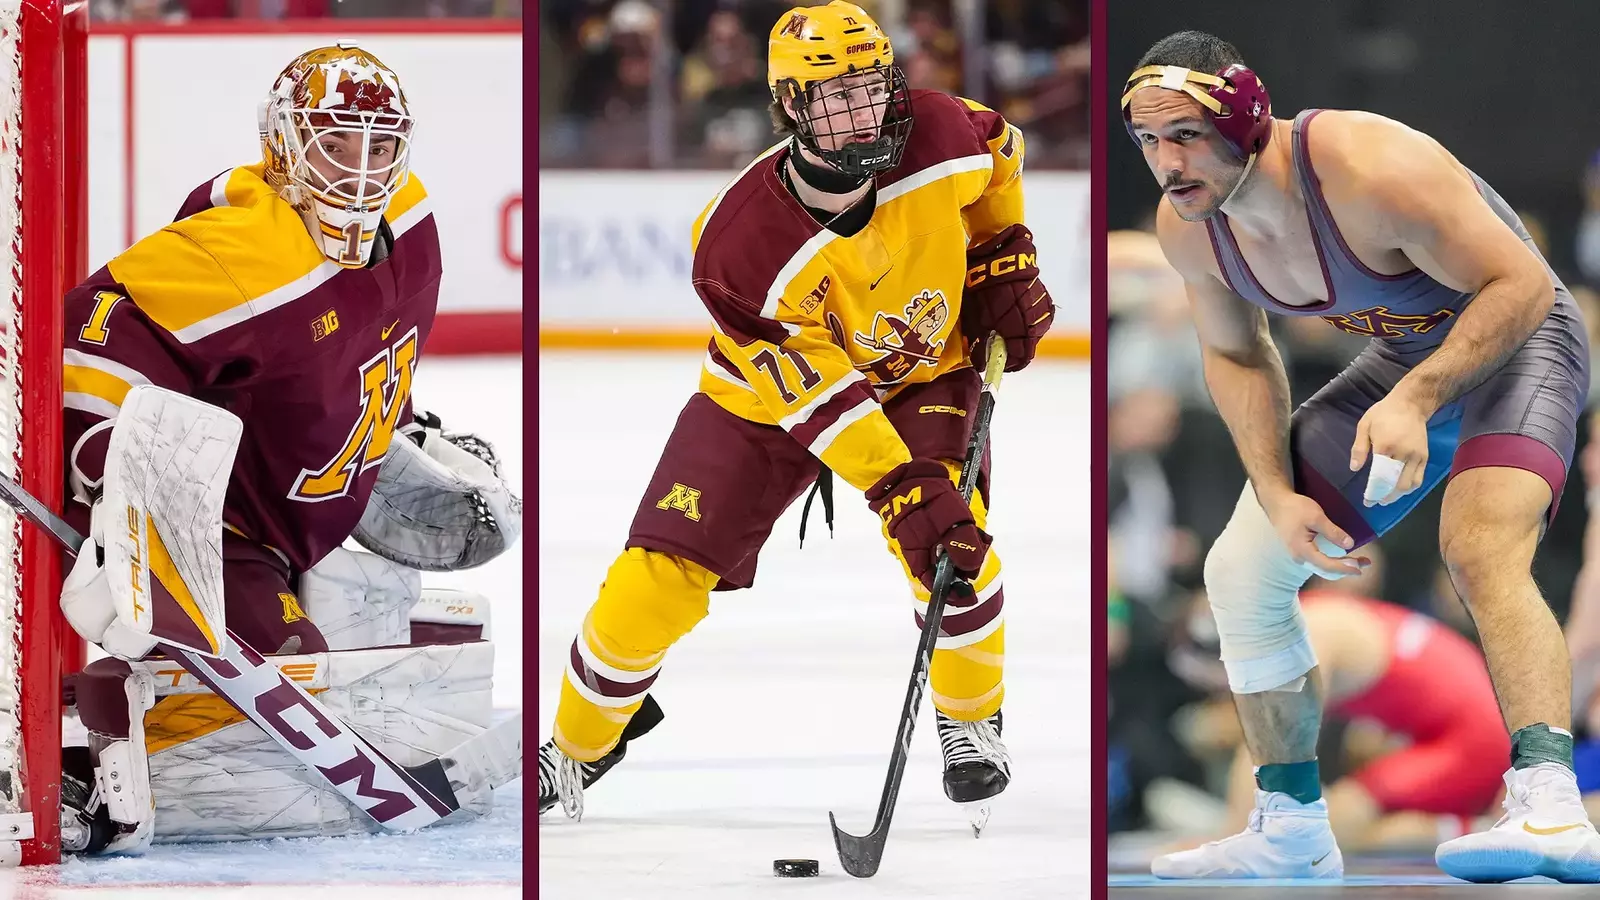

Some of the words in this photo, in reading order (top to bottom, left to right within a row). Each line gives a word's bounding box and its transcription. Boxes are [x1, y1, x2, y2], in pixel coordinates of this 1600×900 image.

[843, 16, 858, 26] 71
[846, 42, 877, 54] GOPHERS
[860, 153, 892, 166] CCM
[339, 219, 363, 265] 1
[966, 252, 1037, 288] CCM
[799, 275, 831, 315] BIG
[78, 291, 126, 346] 1
[311, 307, 339, 342] BIG
[750, 345, 823, 406] 71
[885, 355, 911, 378] M
[286, 325, 418, 503] M
[918, 404, 967, 418] CCM
[656, 482, 702, 522] M
[127, 504, 145, 622] TRUE
[949, 540, 976, 551] CCM
